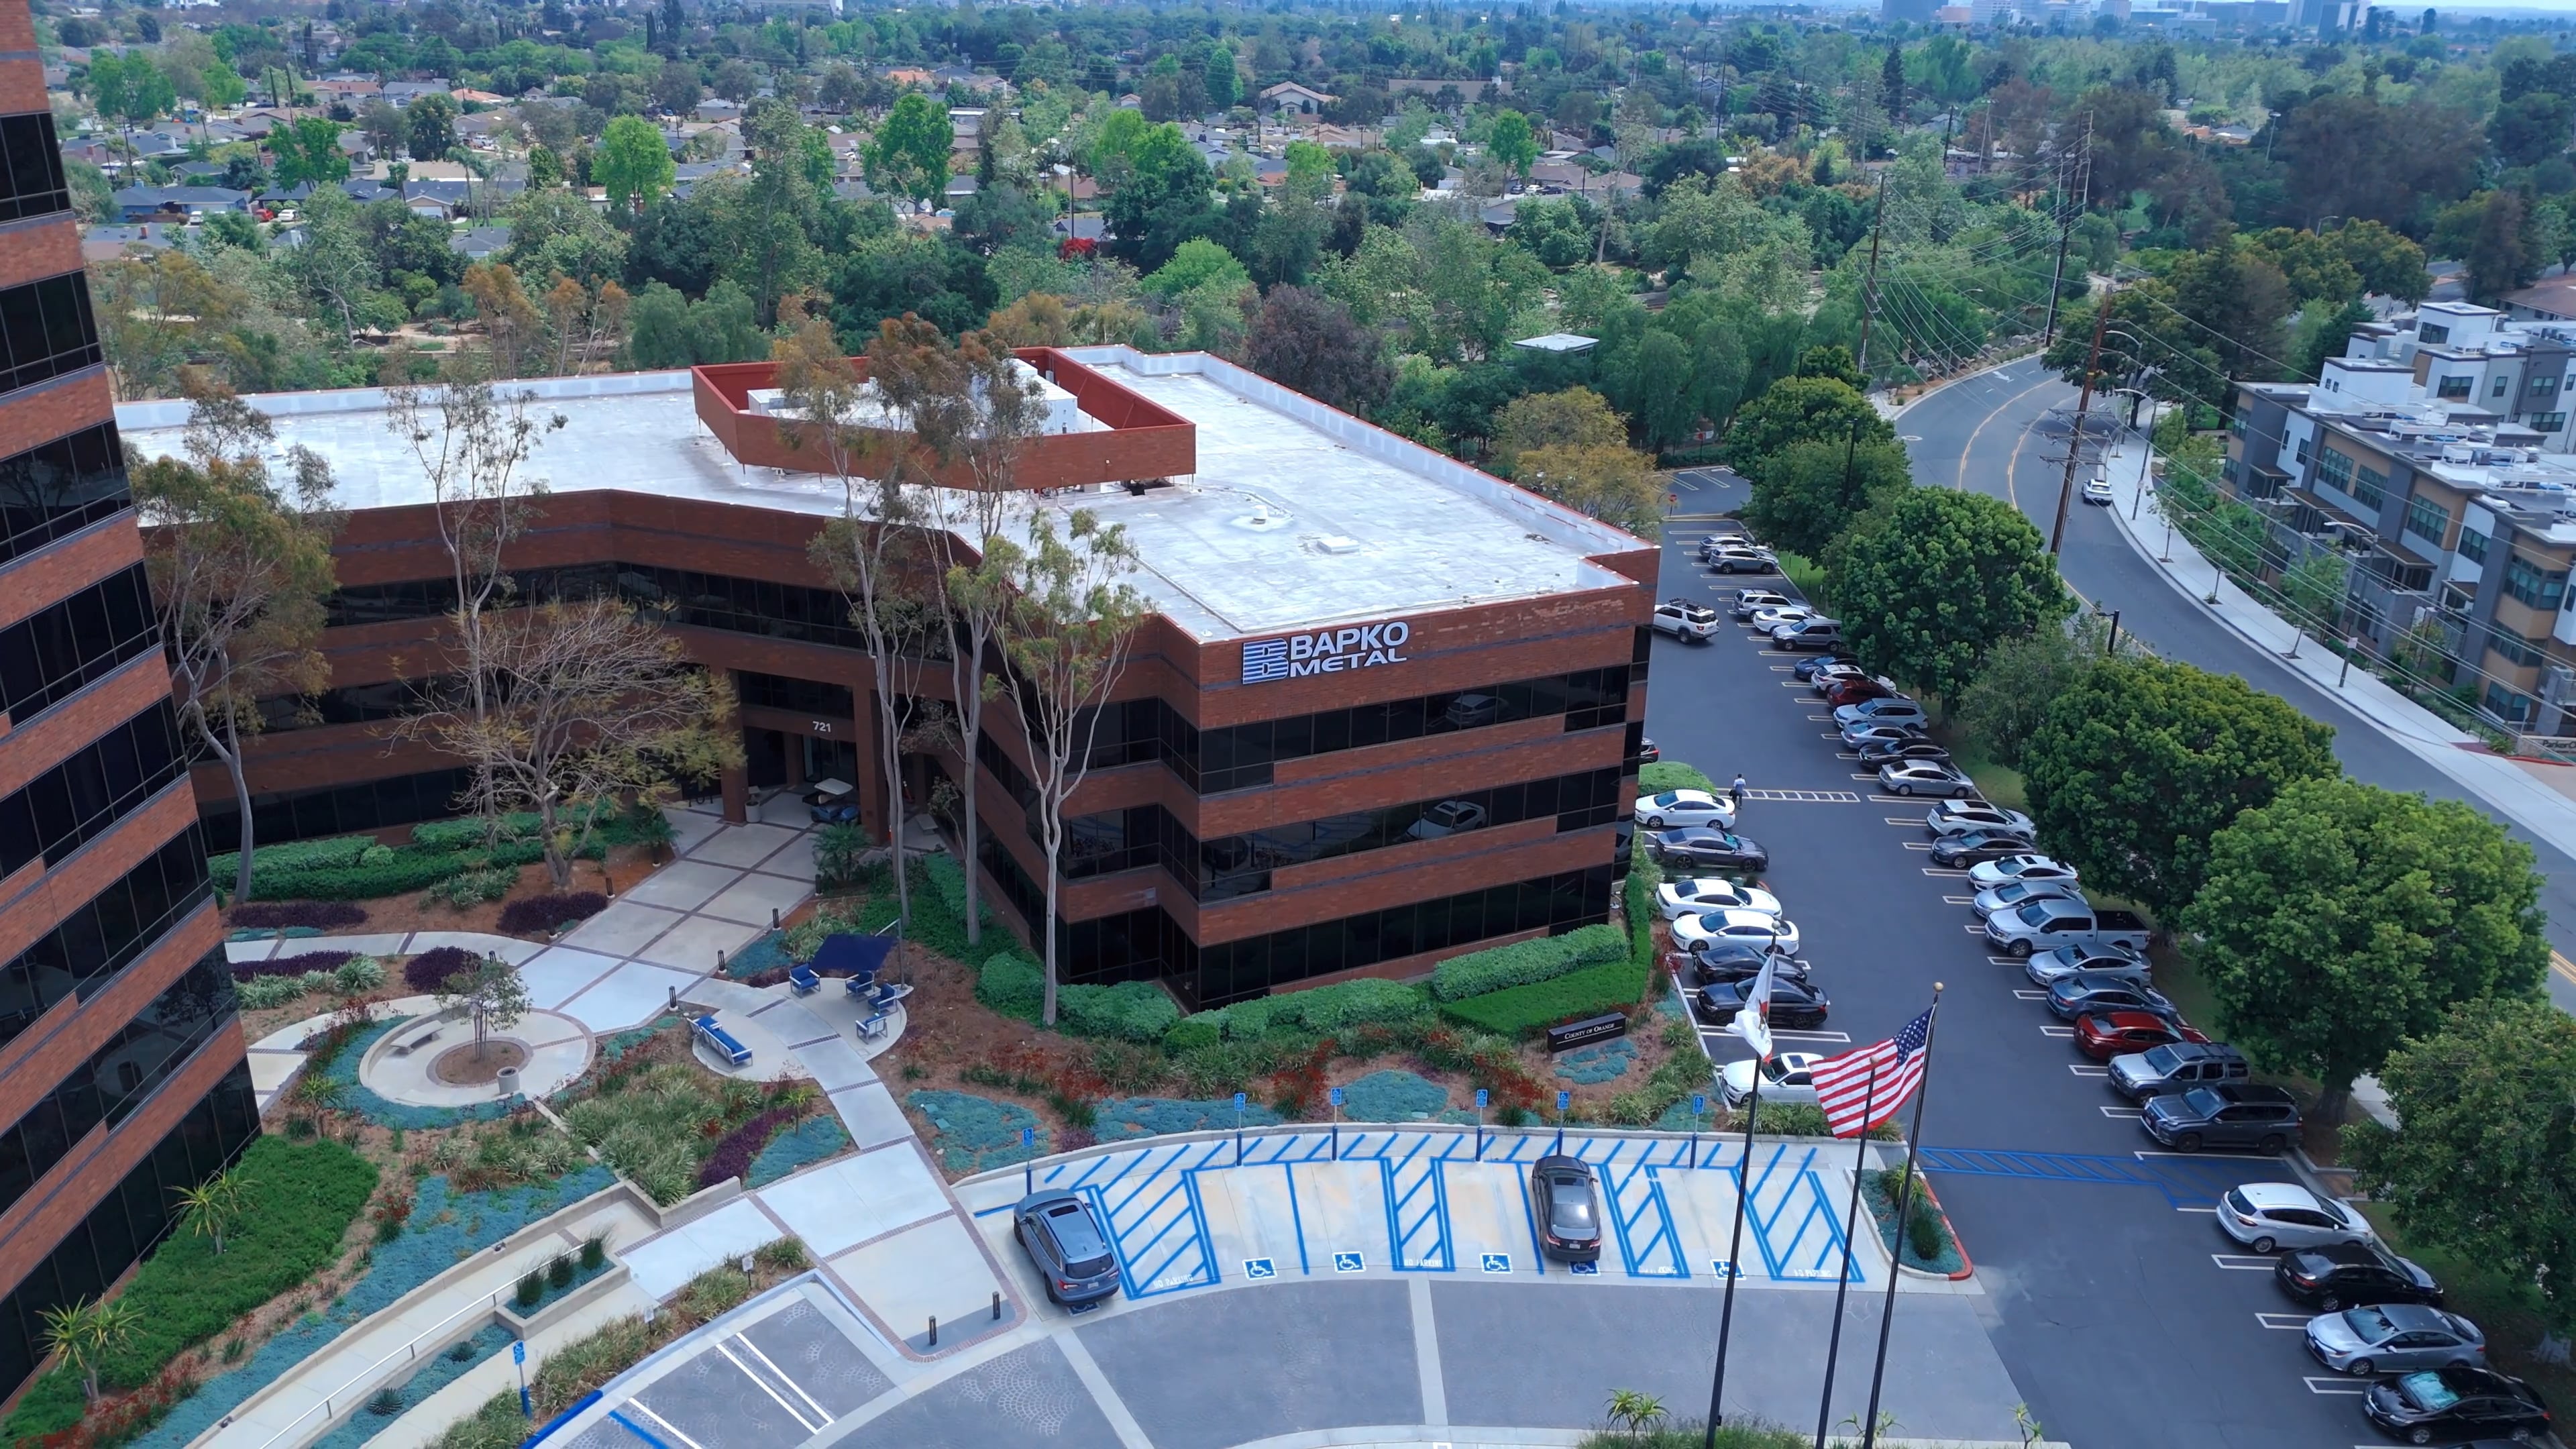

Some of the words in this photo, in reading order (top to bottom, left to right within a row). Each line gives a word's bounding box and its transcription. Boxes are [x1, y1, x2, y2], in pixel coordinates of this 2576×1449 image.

[1290, 621, 1409, 660] BAPKO
[1290, 648, 1407, 678] METAL
[812, 720, 831, 733] 721
[1564, 1030, 1586, 1040] COUNTY
[1593, 1023, 1615, 1032] ORANGE
